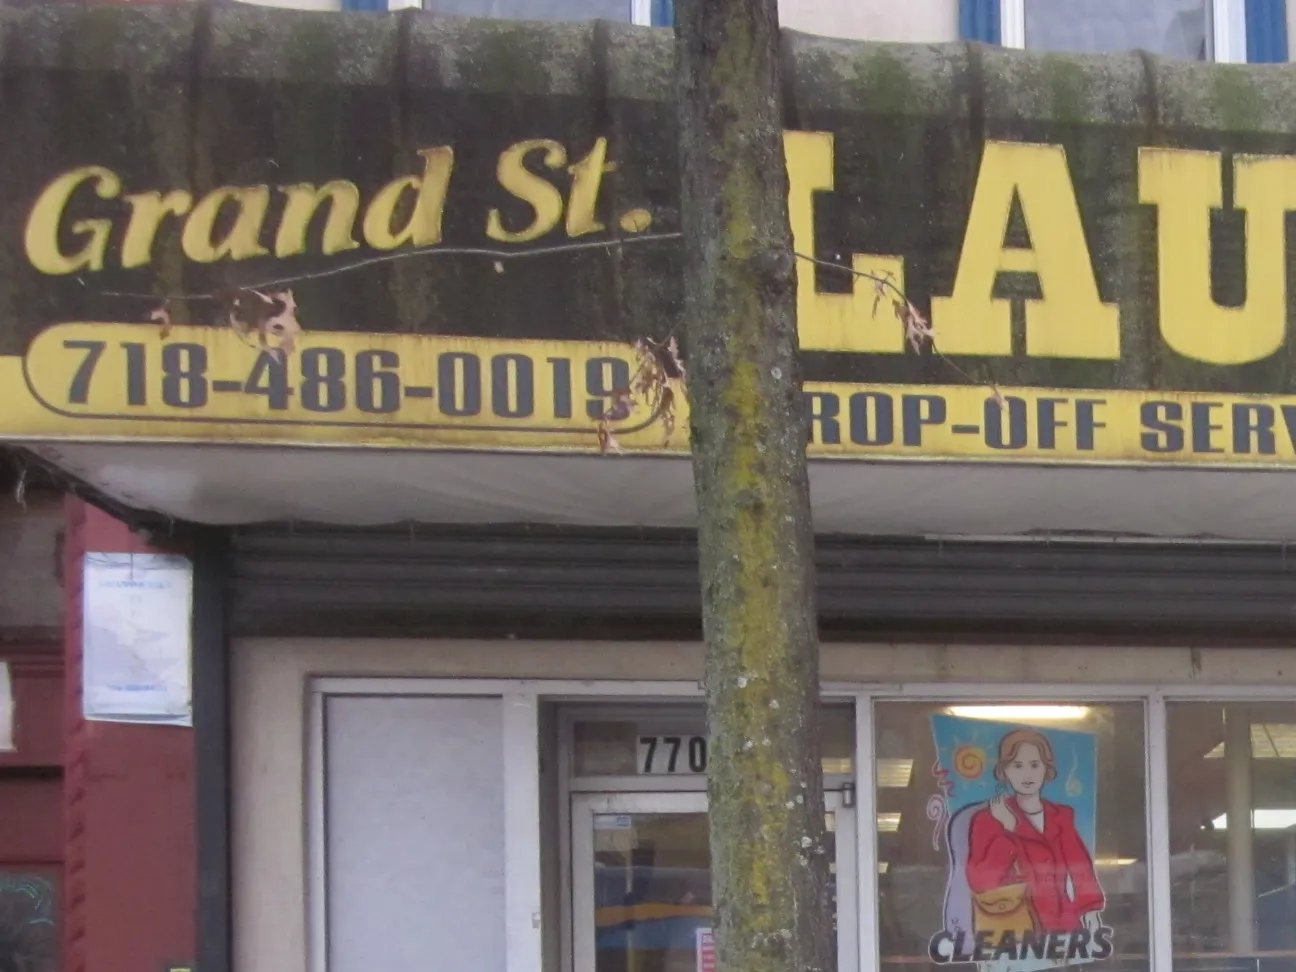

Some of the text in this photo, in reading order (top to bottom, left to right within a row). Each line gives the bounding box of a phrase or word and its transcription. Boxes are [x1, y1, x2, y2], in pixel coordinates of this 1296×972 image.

[25, 137, 652, 276] Grand St.
[62, 340, 632, 421] 718-486-0019
[803, 391, 1107, 453] ROP-OFF
[640, 736, 707, 773] 770
[929, 928, 1113, 963] CLEANERS
